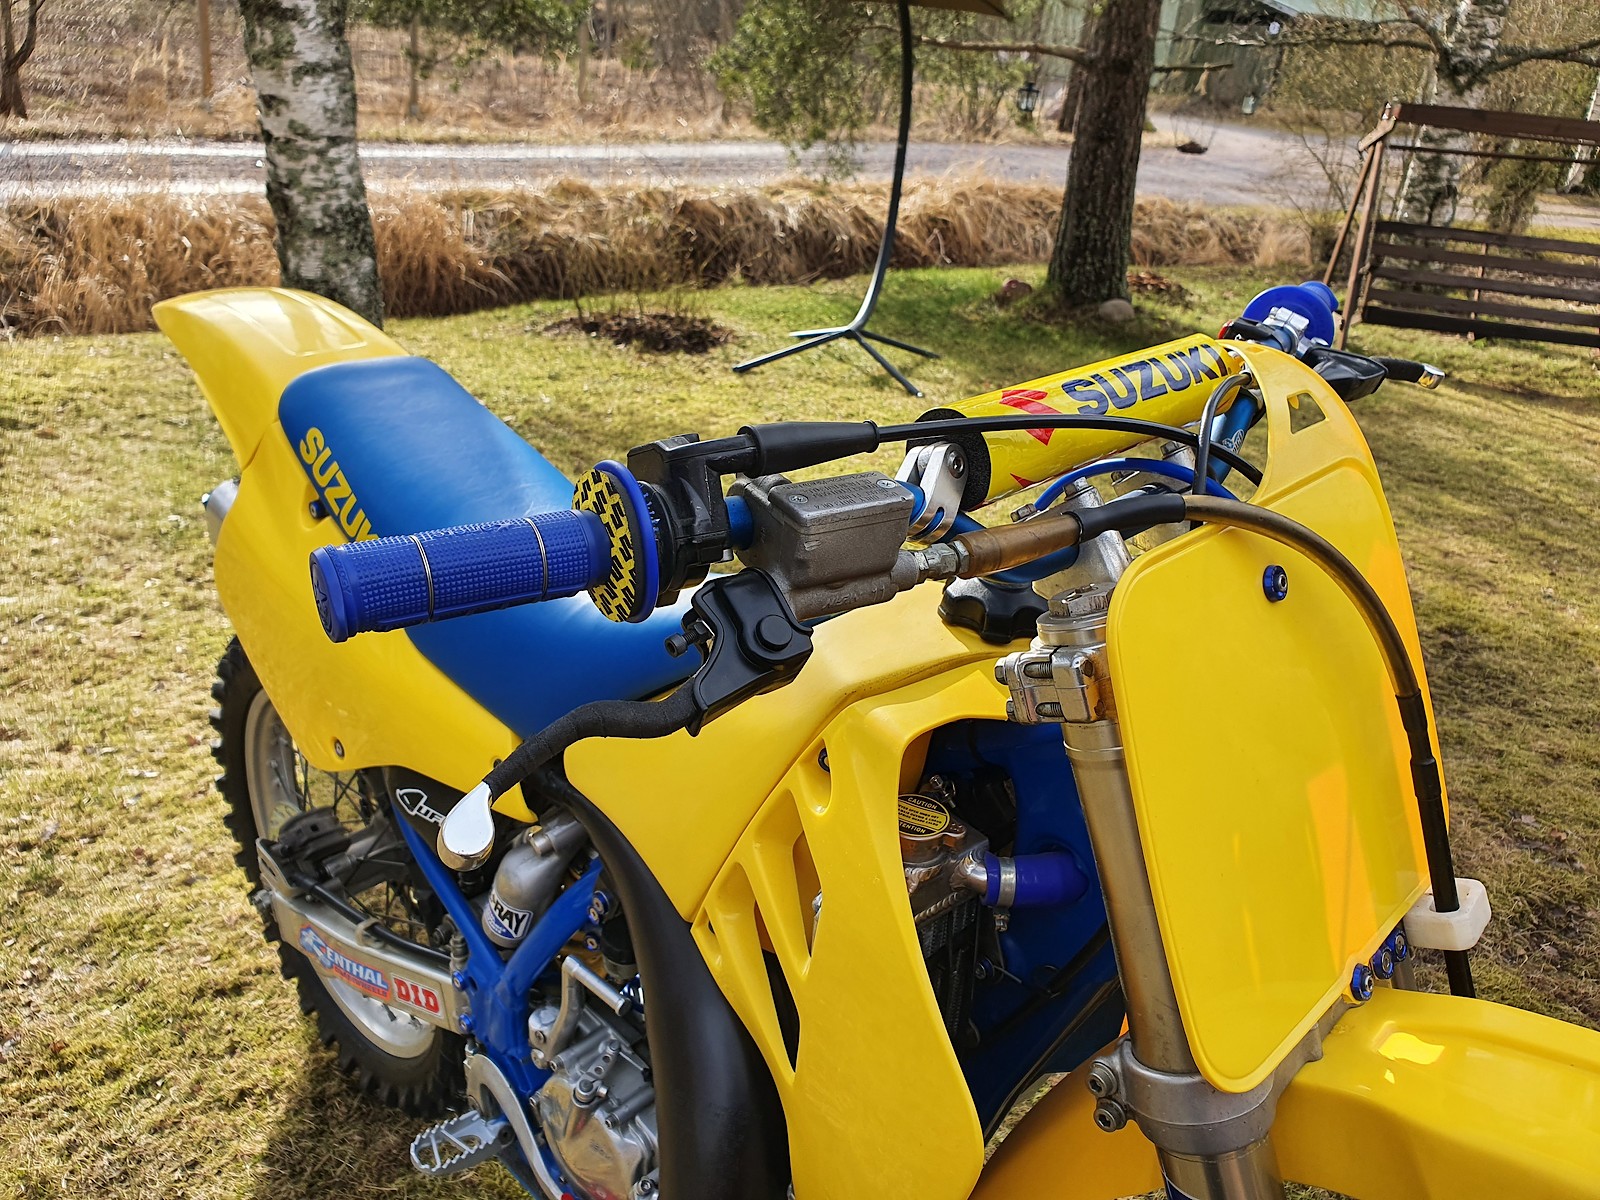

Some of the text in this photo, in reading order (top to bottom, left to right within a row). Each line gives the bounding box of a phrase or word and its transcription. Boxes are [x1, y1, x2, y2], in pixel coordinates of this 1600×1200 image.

[1062, 343, 1228, 416] SUZUKI
[300, 427, 380, 541] SUZUK
[907, 797, 938, 810] CAUTION
[900, 821, 926, 834] TENTION
[491, 894, 528, 935] RAY
[393, 976, 440, 1014] DID
